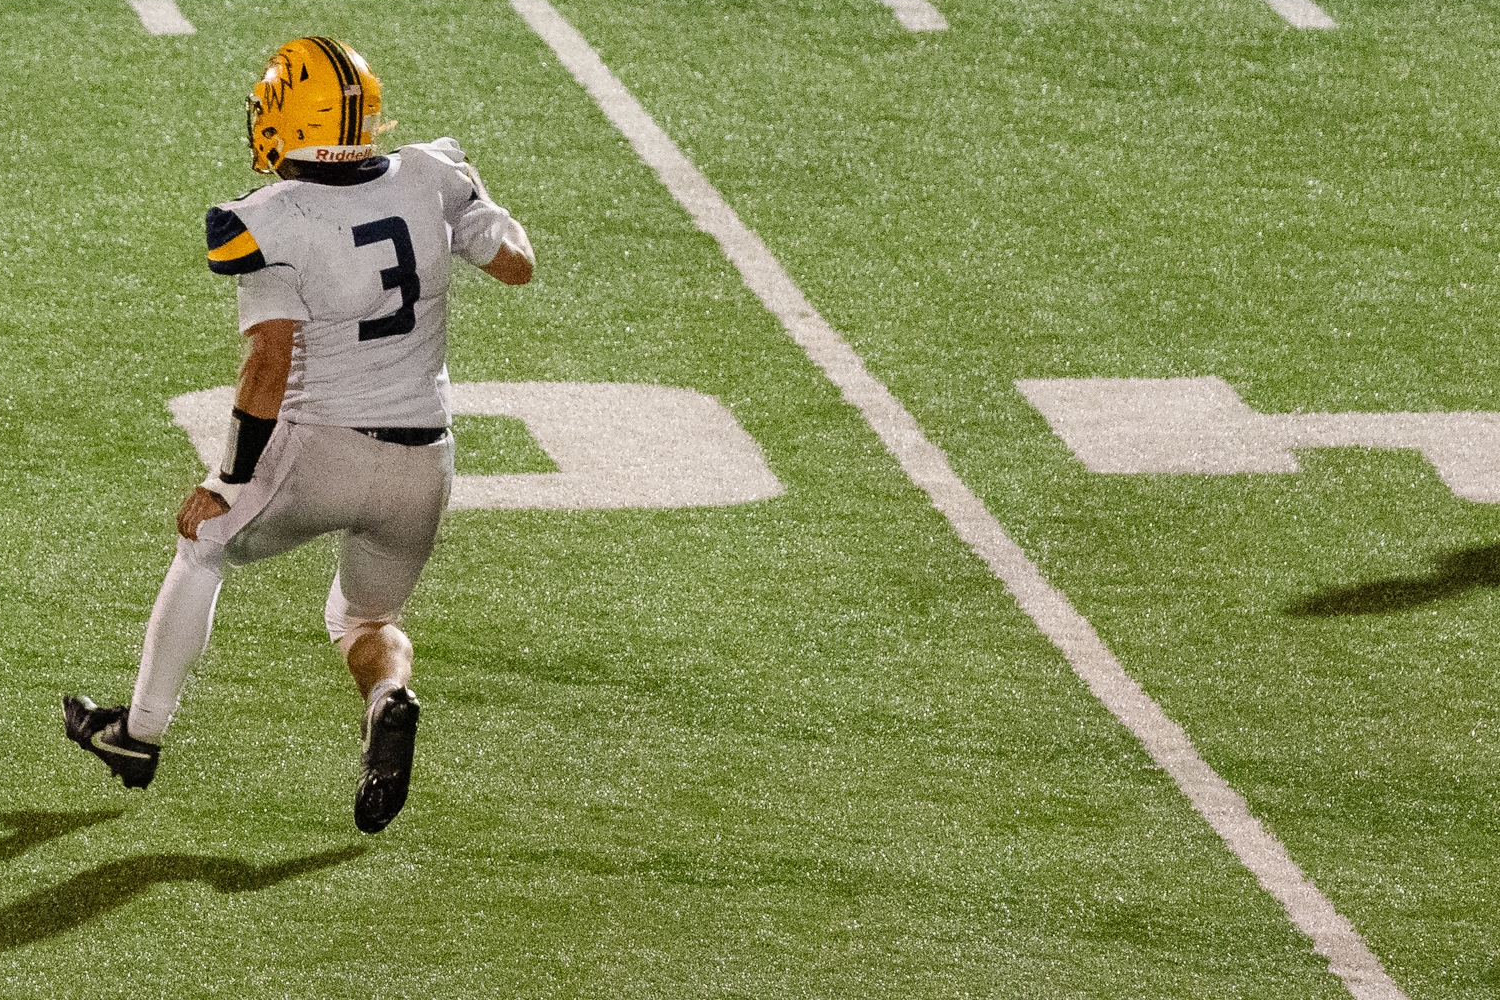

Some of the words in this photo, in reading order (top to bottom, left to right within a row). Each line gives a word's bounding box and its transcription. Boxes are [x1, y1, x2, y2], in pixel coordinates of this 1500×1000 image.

[296, 129, 305, 140] 3
[315, 148, 373, 163] Riddell
[352, 215, 421, 342] 3
